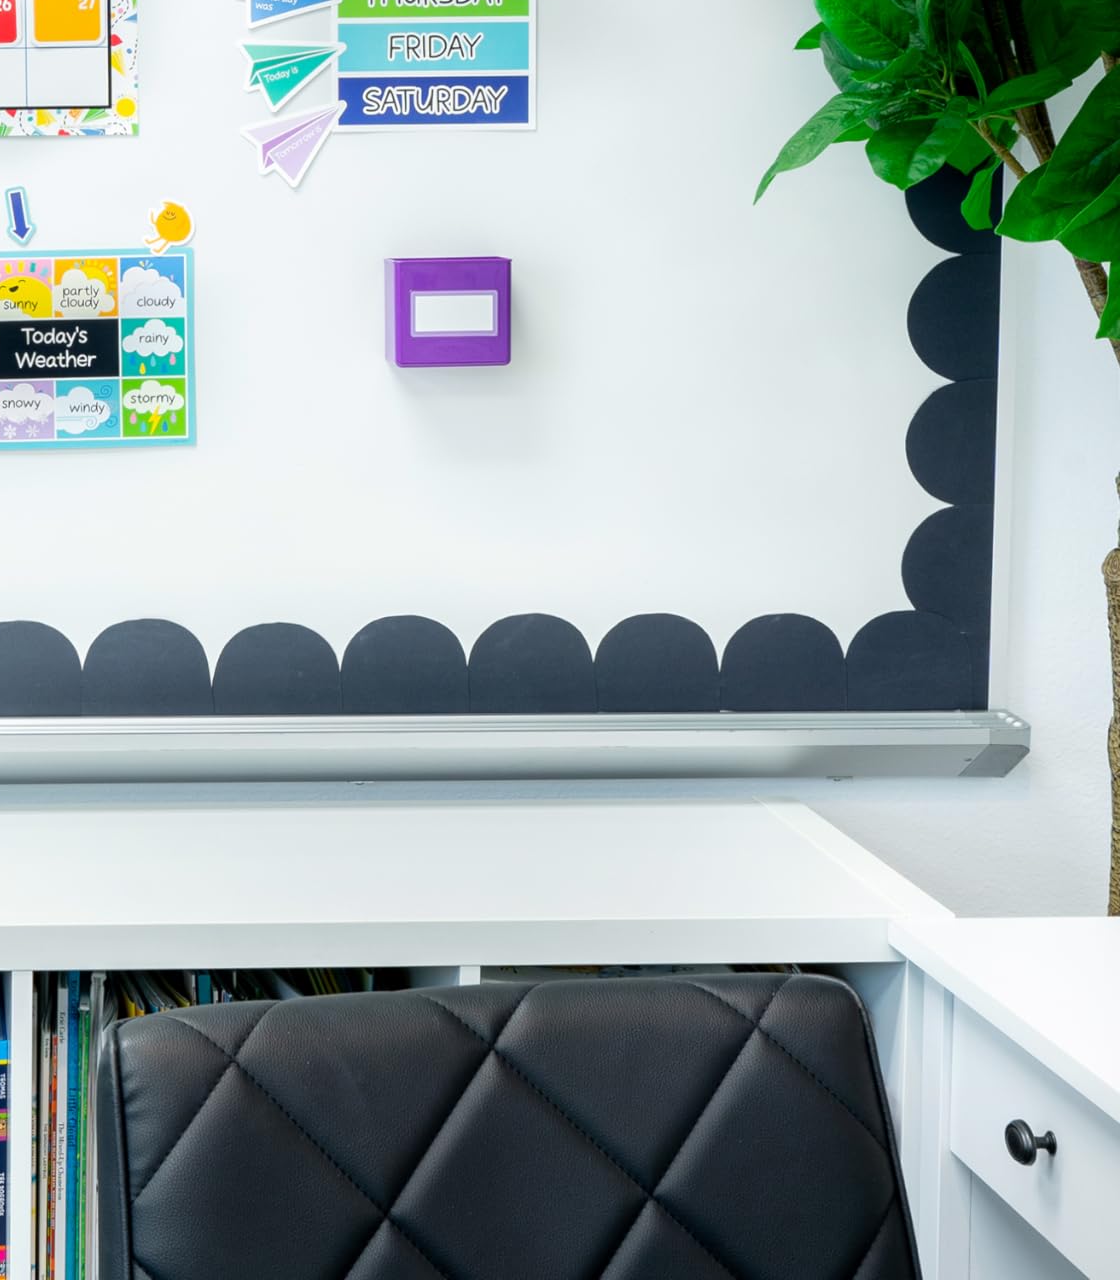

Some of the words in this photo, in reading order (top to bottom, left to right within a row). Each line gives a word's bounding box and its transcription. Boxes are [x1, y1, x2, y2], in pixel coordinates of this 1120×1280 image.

[255, 2, 273, 11] was
[386, 33, 482, 60] FRIDAY
[263, 67, 290, 84] Today
[290, 66, 299, 75] is
[362, 86, 507, 114] SATURDAY
[62, 285, 100, 298] partly
[3, 299, 38, 312] sunny
[59, 297, 99, 310] cloudy
[136, 296, 176, 309] cloudy
[20, 326, 88, 348] Today's
[138, 333, 169, 346] rainy
[14, 349, 97, 369] Weather
[1, 399, 41, 410] snowy
[130, 392, 176, 405] stormy
[69, 401, 106, 415] windy
